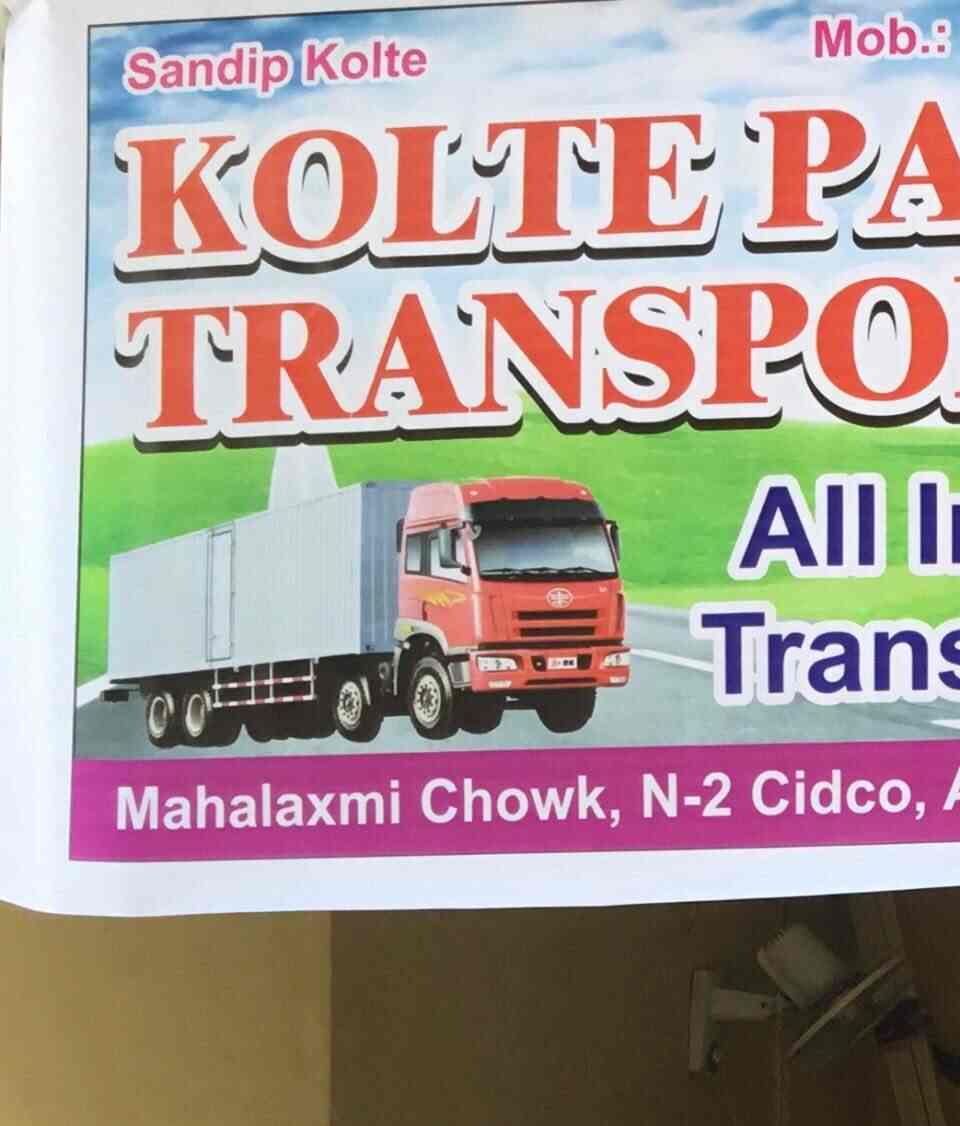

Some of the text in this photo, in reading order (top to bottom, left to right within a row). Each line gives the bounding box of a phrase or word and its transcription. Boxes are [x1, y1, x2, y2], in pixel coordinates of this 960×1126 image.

[126, 41, 428, 92] Sandip Kolte
[813, 18, 947, 58] Mob.:
[125, 113, 708, 259] KOLTE
[738, 483, 876, 570] All
[115, 779, 400, 831] Mahalaxmi
[420, 775, 621, 827] Chowk,
[641, 771, 732, 820] N-2
[751, 768, 925, 821] Cidco,
